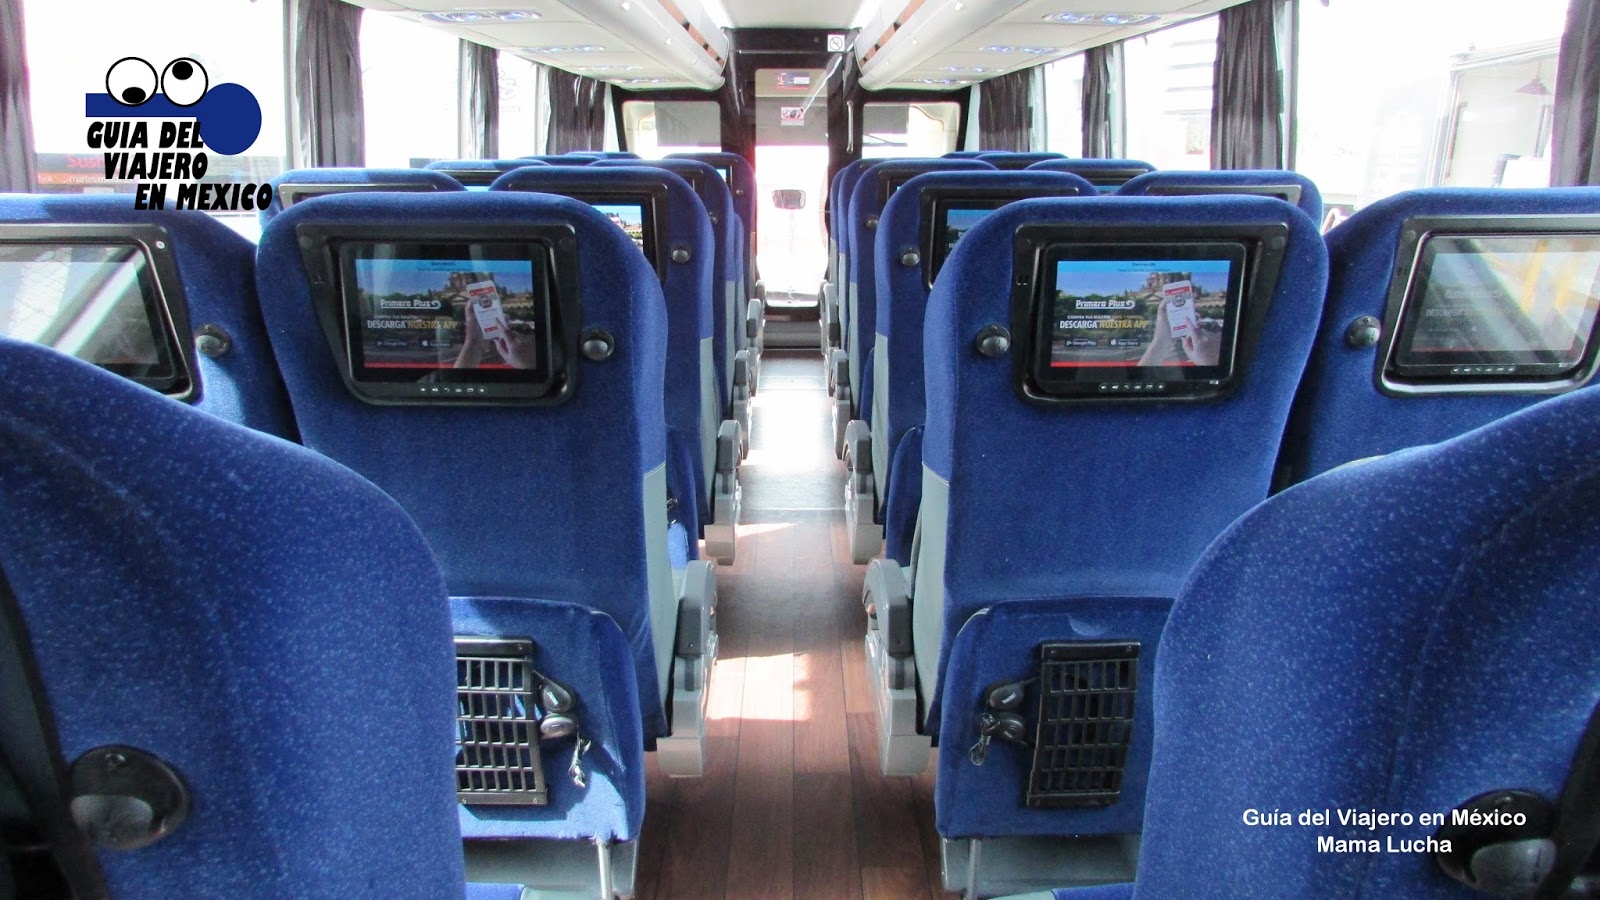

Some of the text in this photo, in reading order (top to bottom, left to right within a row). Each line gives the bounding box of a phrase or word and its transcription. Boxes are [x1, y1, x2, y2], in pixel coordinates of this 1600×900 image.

[381, 299, 431, 308] Primera Plus
[1075, 299, 1125, 309] Primera Plus
[367, 320, 458, 329] DESCARGA NUESTRA APP
[1060, 320, 1149, 329] DESCARGA NUESTRA APP
